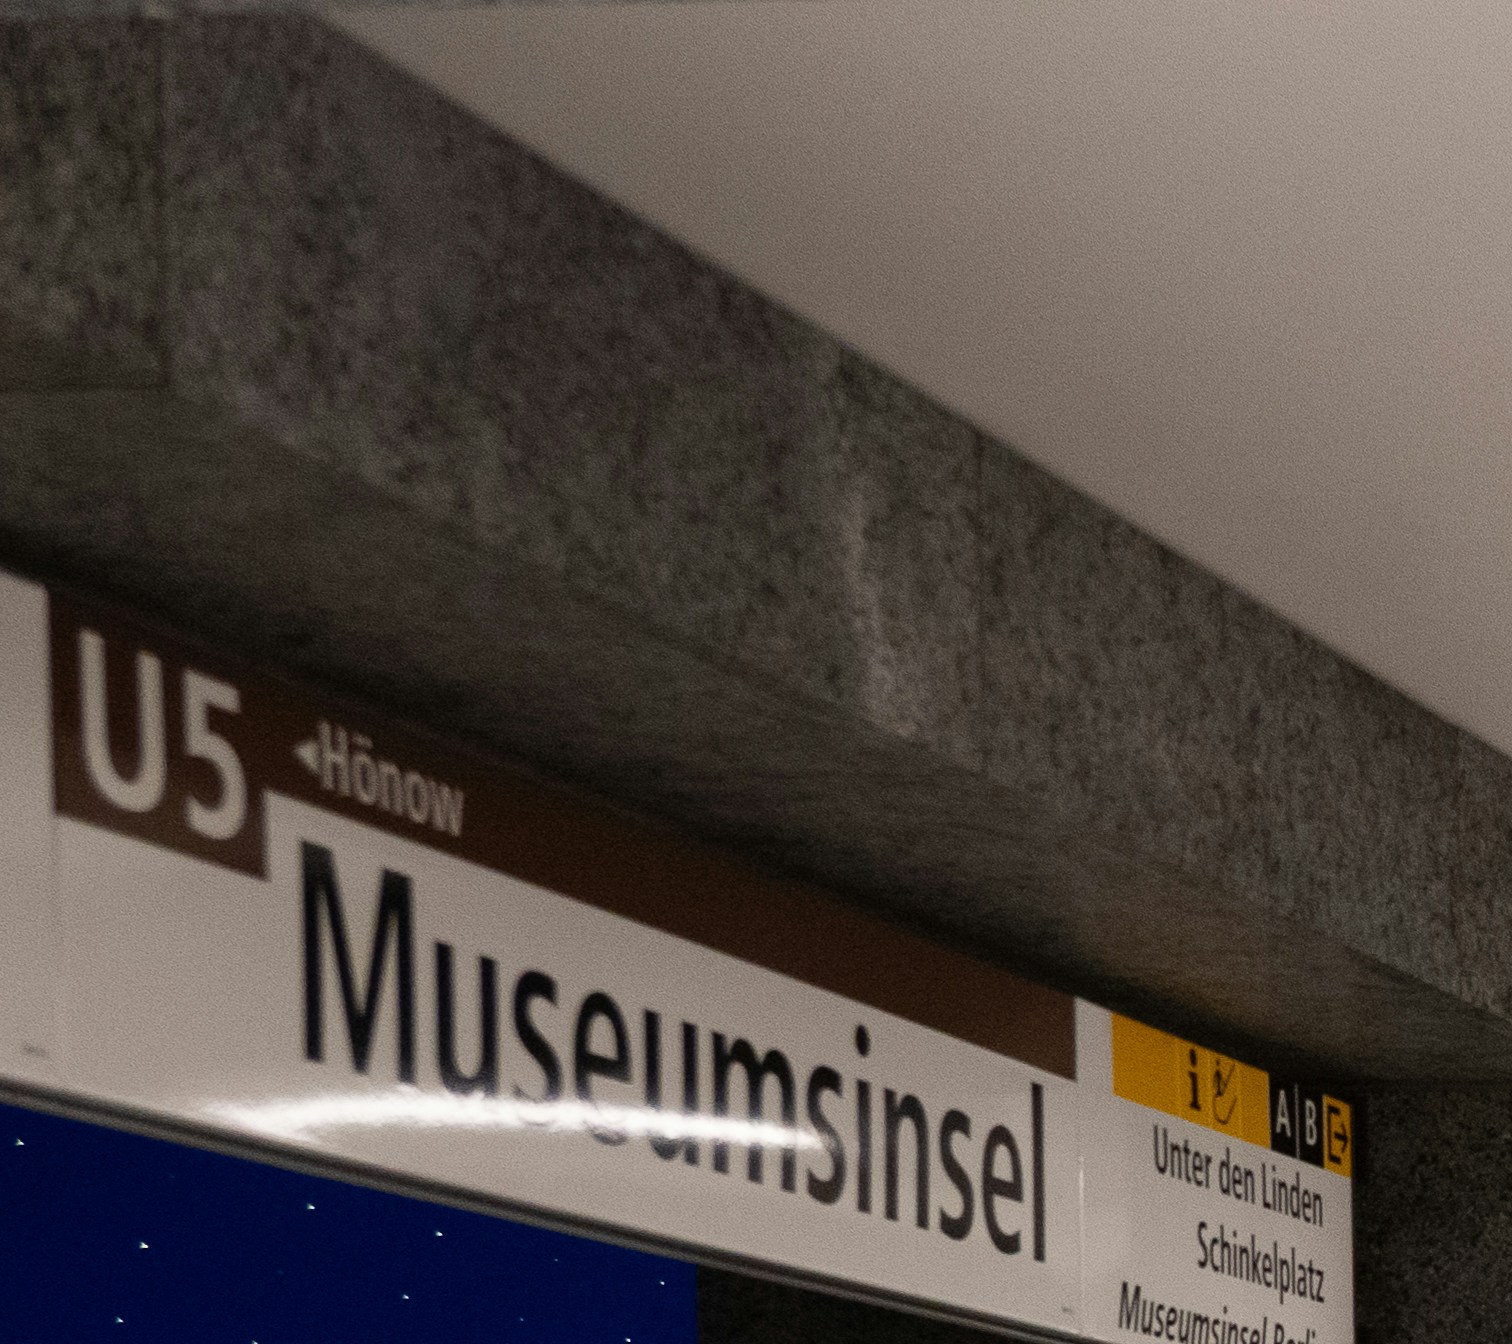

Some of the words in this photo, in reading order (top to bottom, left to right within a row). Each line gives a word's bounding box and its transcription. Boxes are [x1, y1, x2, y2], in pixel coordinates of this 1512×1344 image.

[77, 627, 250, 841] U5
[316, 719, 465, 839] Hönow
[300, 840, 1048, 1263] Museumsinsel
[1274, 1087, 1293, 1139] A
[1303, 1100, 1318, 1147] B
[1152, 1124, 1213, 1190] Unter
[1218, 1148, 1256, 1206] den
[1260, 1163, 1325, 1228] Linden
[1196, 1221, 1325, 1304] Schinkelplatz
